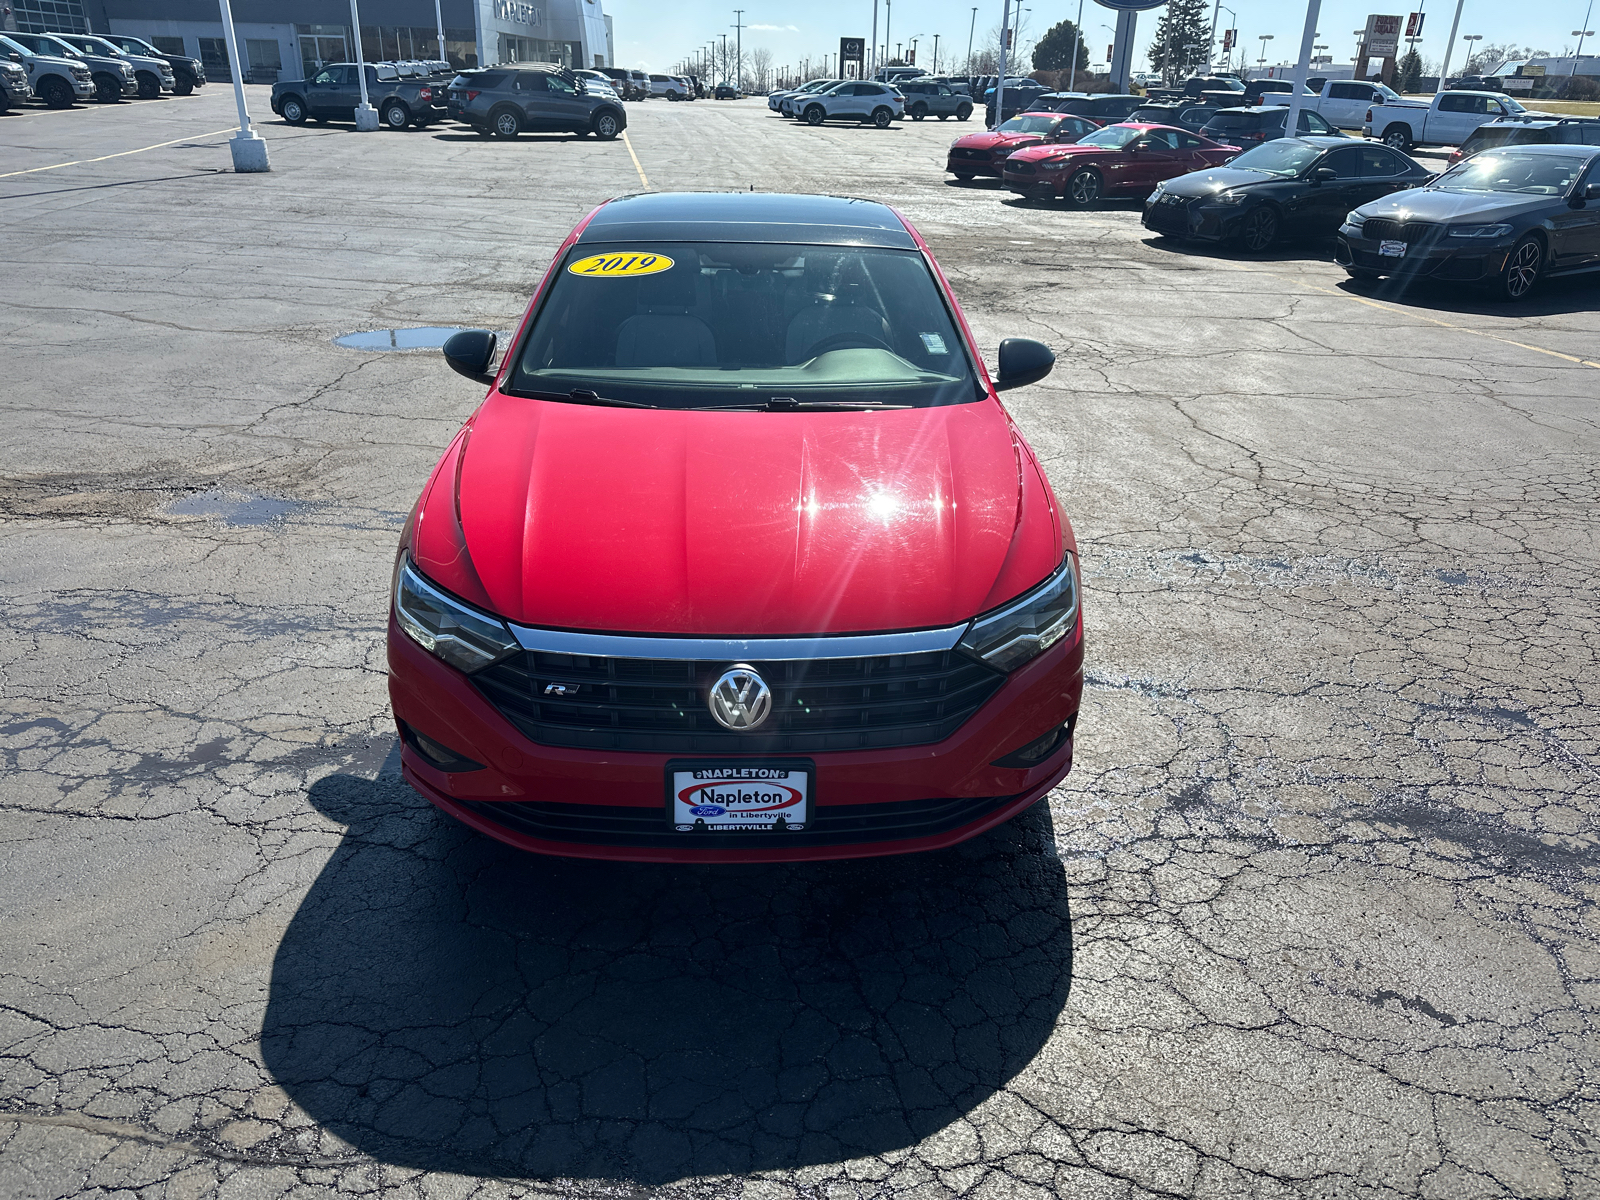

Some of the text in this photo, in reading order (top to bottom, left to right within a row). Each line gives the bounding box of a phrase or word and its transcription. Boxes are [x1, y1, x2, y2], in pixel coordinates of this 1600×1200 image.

[494, 0, 542, 27] NAPLETON
[583, 256, 657, 272] 2019
[701, 768, 780, 779] NAPLETON
[700, 789, 783, 807] Napleton
[697, 807, 719, 816] Ford
[740, 811, 792, 819] Libertyville
